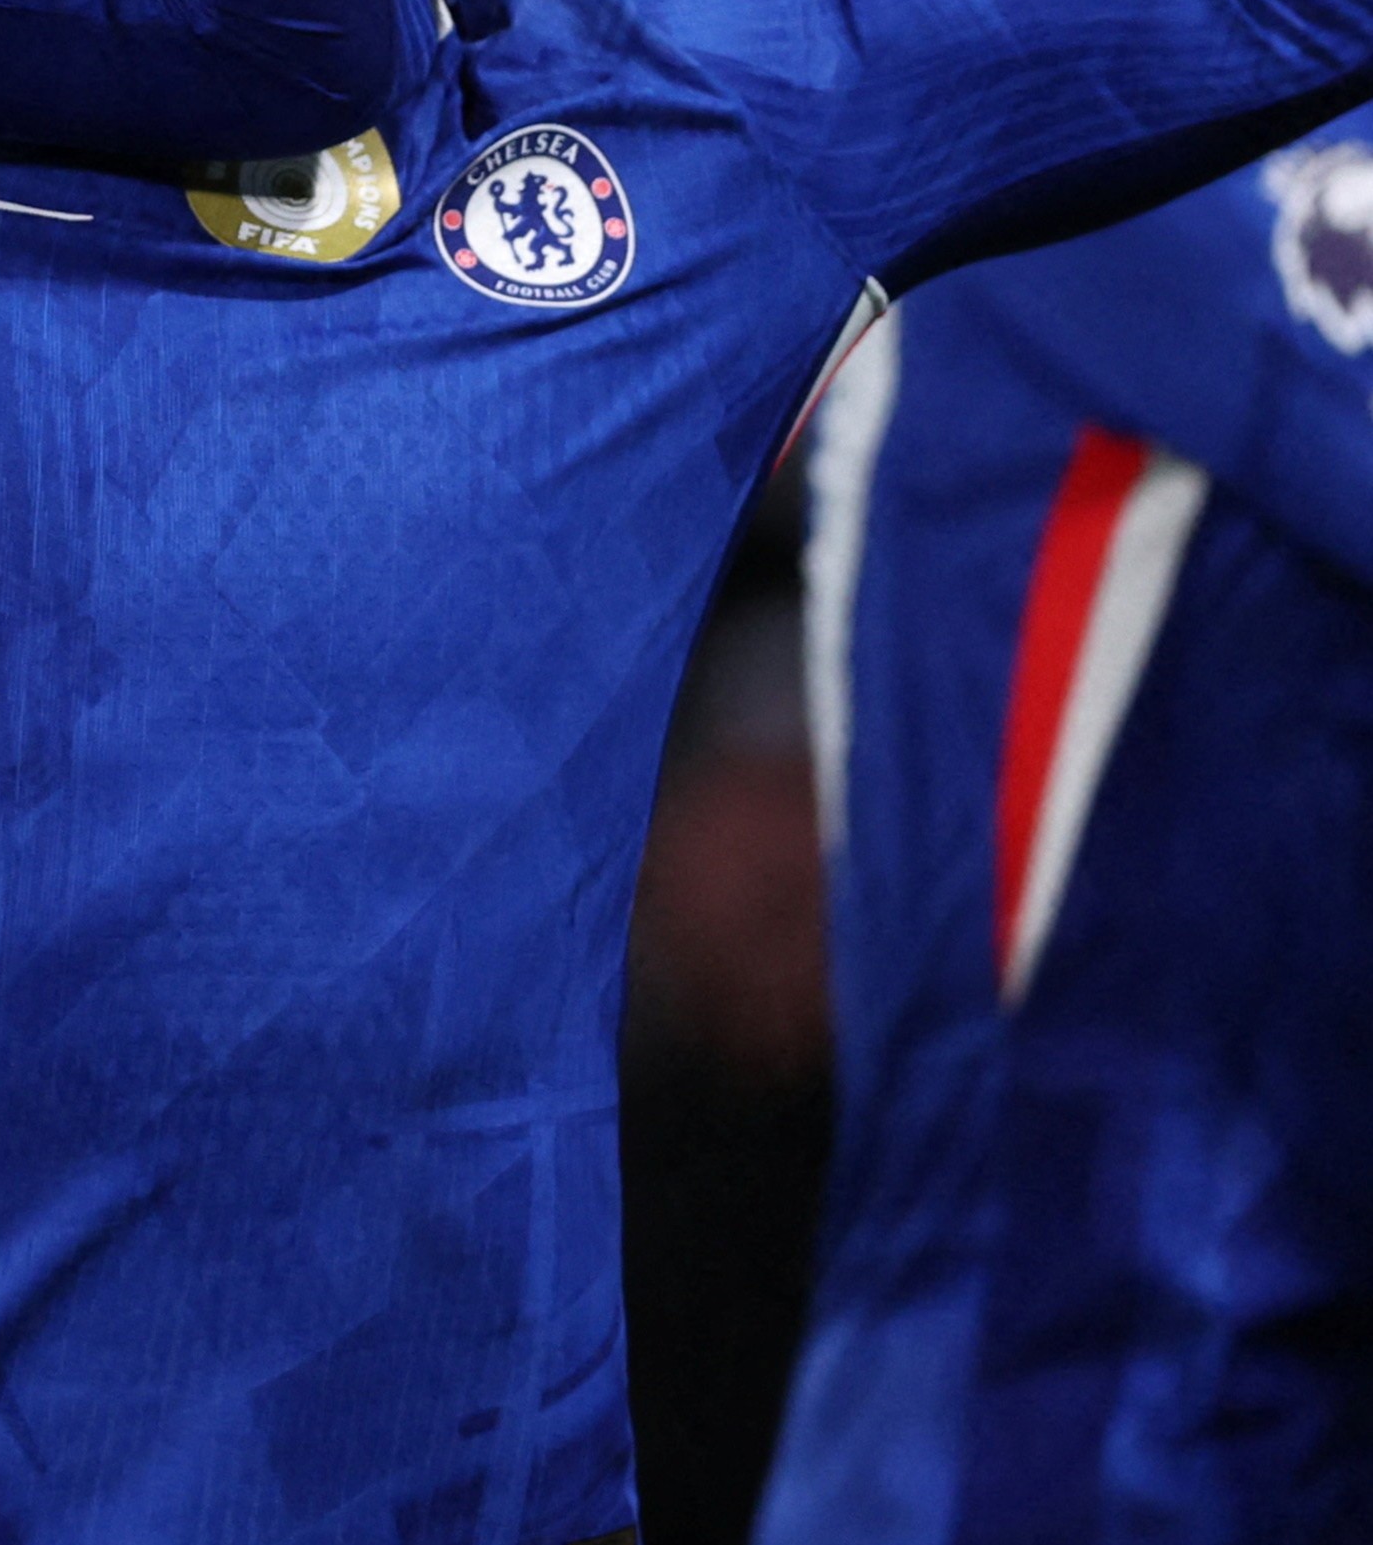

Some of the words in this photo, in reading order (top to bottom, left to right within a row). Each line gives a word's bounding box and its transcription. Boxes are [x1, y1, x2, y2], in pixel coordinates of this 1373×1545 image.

[466, 132, 579, 185] CHELSEA
[342, 138, 382, 230] MPIONS
[237, 221, 318, 254] FIFA
[494, 279, 584, 298] FOOTBALL
[586, 259, 618, 288] CLUB
